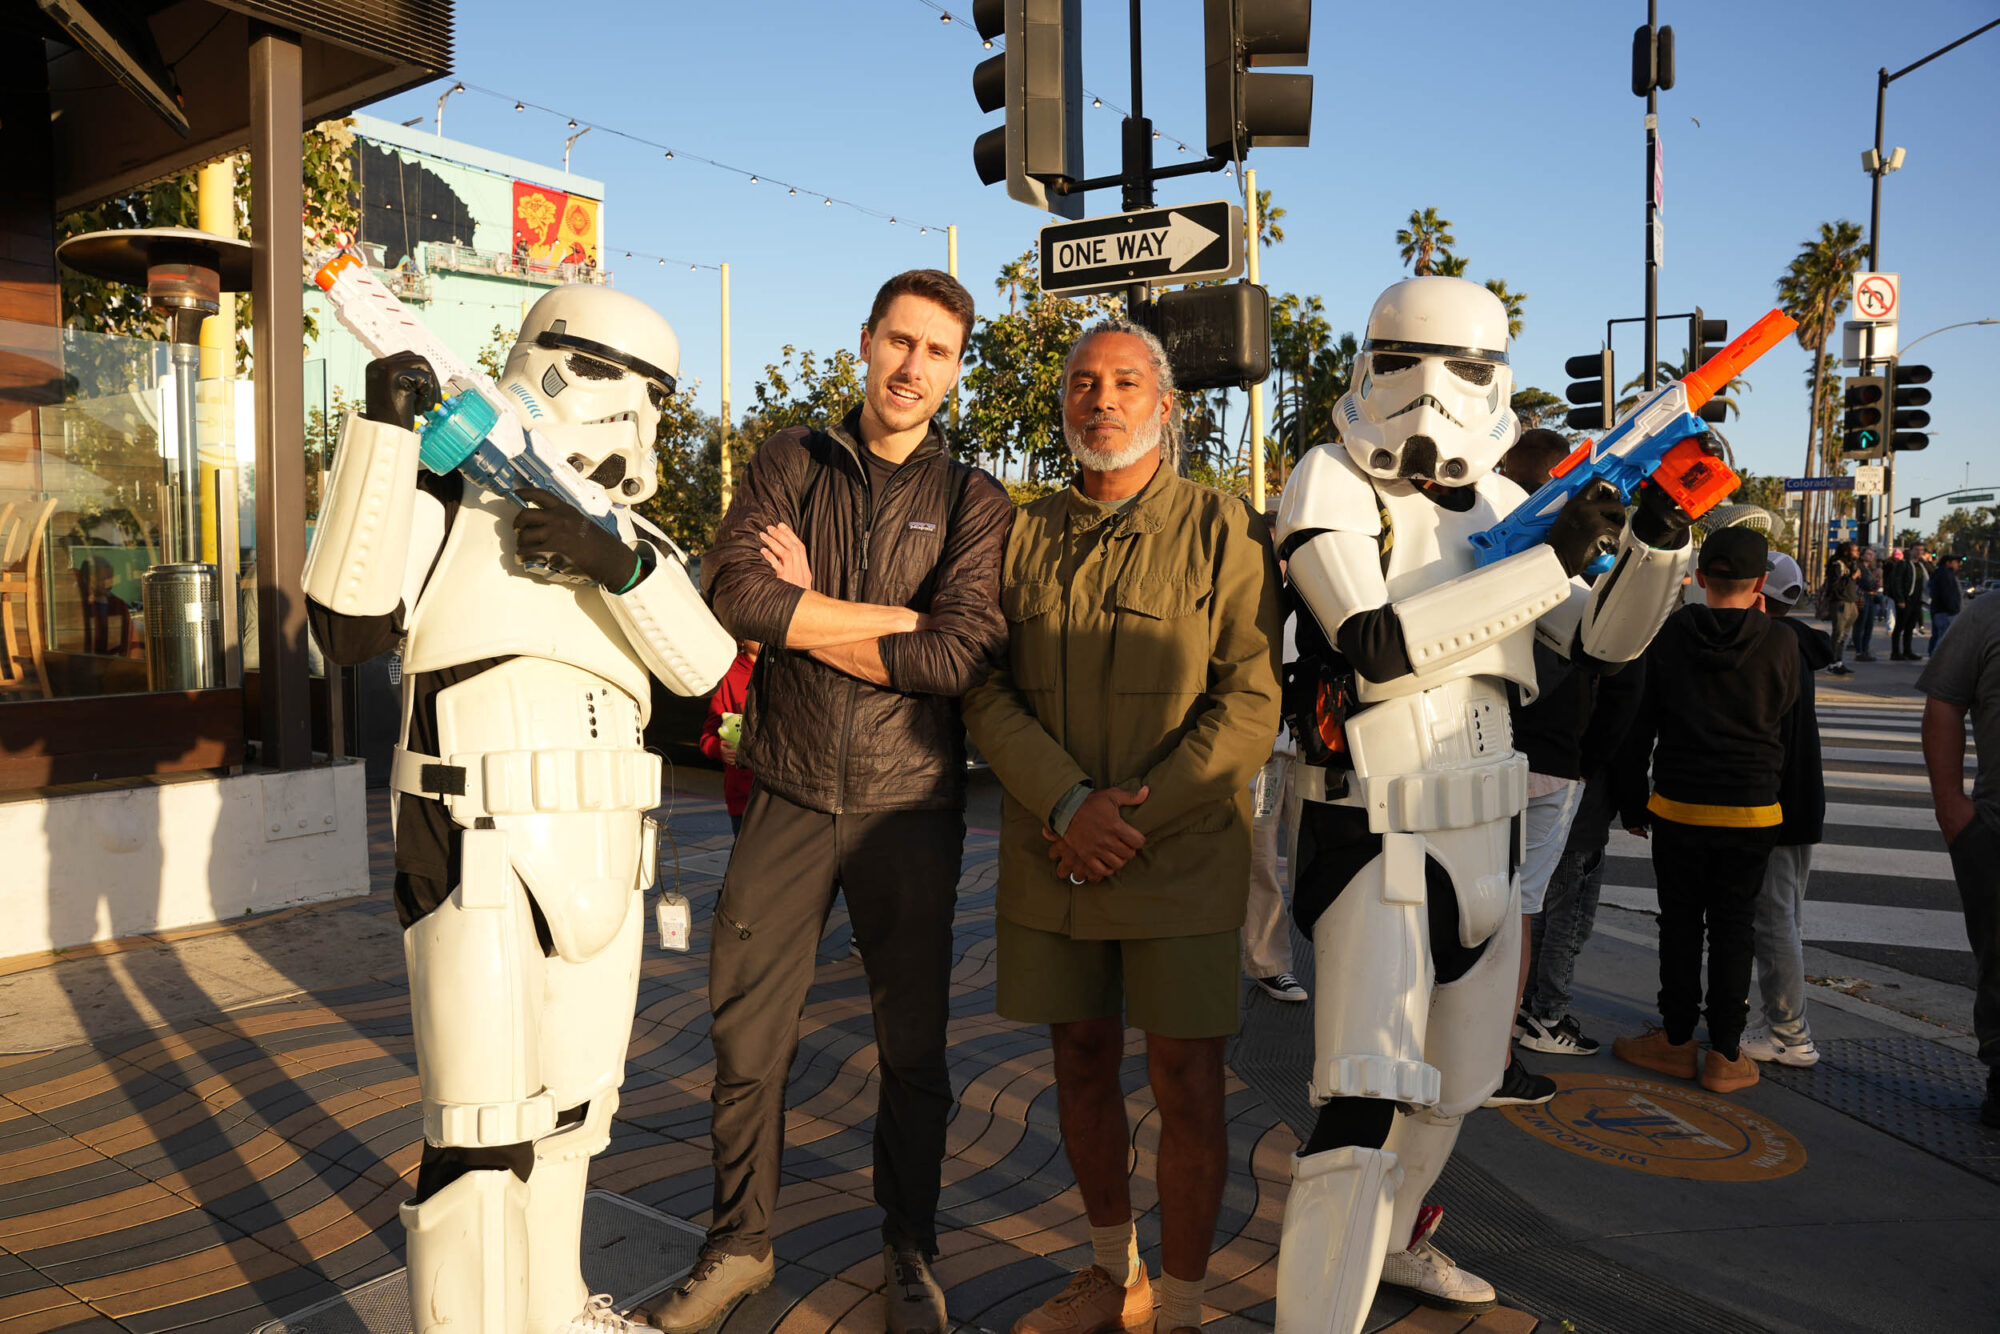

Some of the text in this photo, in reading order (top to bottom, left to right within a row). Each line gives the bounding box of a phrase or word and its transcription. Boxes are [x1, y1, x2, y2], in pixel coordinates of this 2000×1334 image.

[1059, 230, 1169, 269] ONE WAY
[1786, 479, 1834, 489] Colorado
[1521, 1115, 1647, 1166] DISMOUNT
